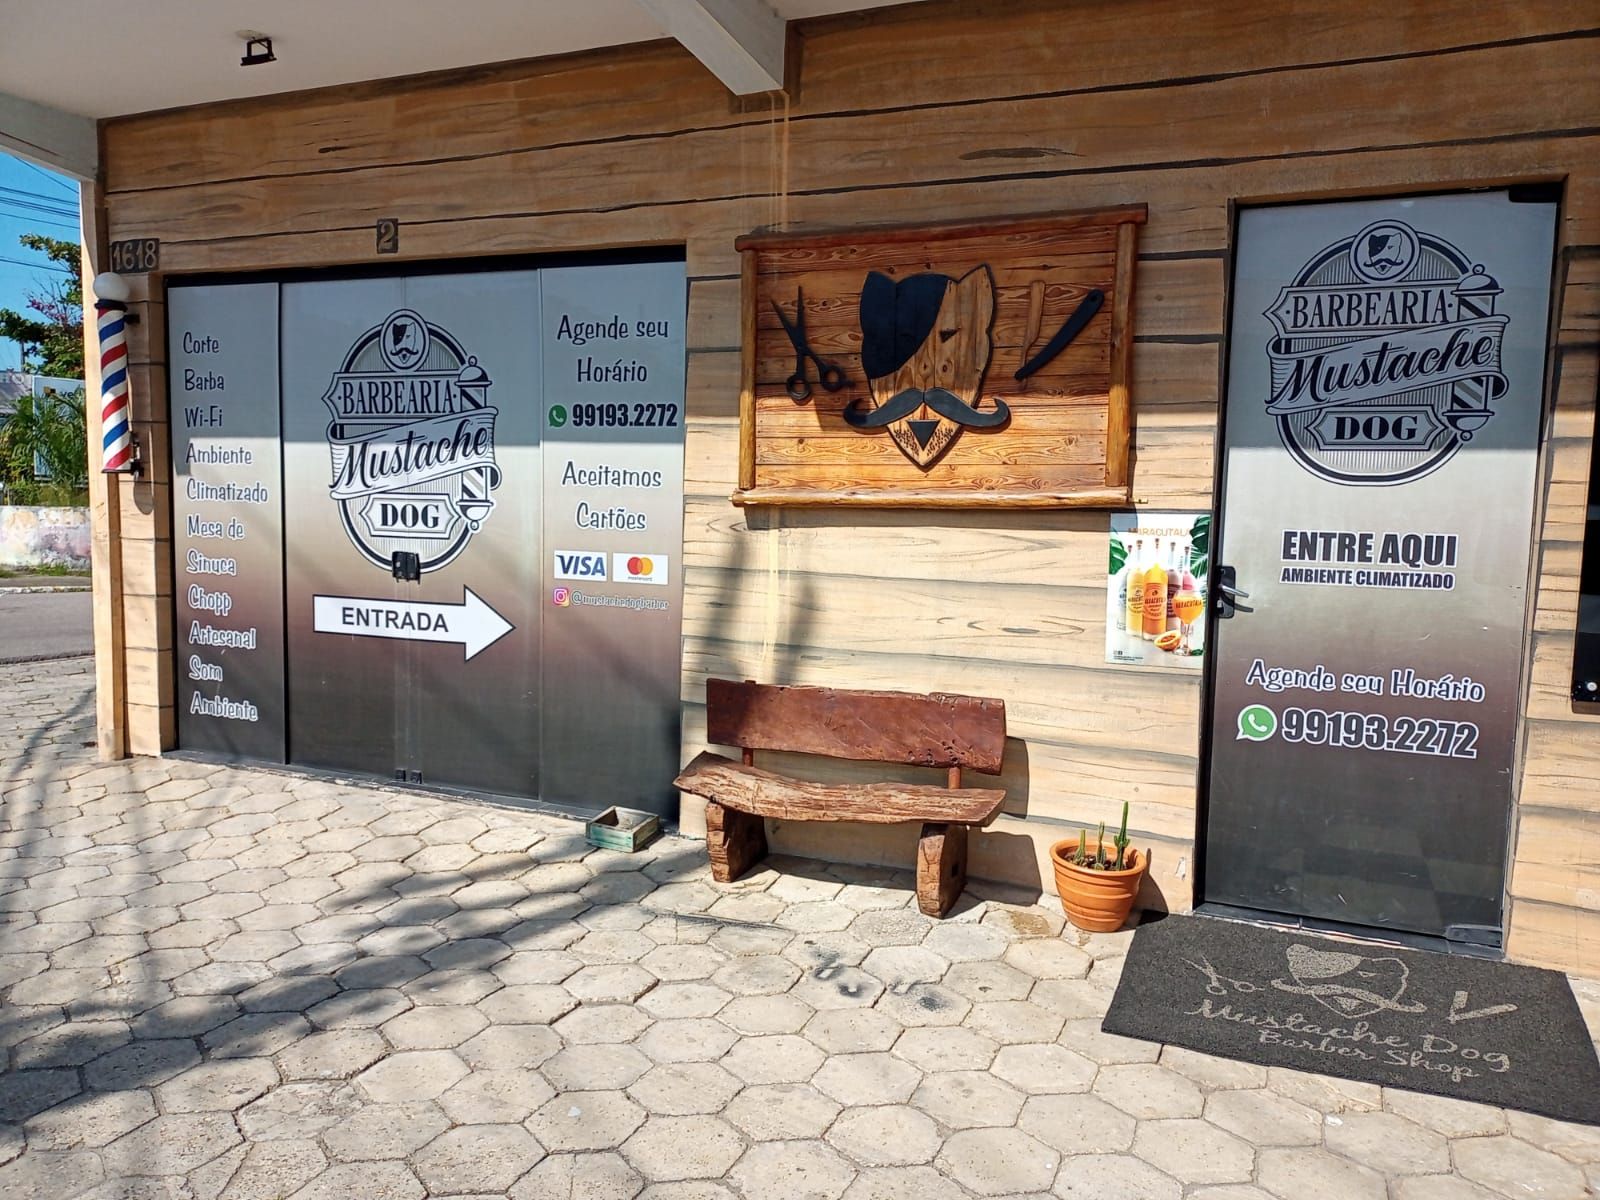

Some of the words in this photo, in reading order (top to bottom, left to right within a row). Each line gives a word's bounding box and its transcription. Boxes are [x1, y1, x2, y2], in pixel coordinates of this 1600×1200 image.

[380, 221, 395, 250] 2
[112, 240, 157, 270] 1618
[1291, 289, 1450, 329] BARBEARIA
[183, 331, 220, 354] Corte
[556, 314, 629, 346] Agende
[636, 321, 669, 338] seu
[184, 368, 225, 391] Barba
[577, 356, 648, 383] Horário
[1264, 327, 1495, 405] Mustache
[342, 379, 456, 415] BARBEARIA
[184, 405, 224, 429] Wi-Fi
[572, 403, 678, 427] 99193.2272
[1334, 415, 1418, 441] DOG
[186, 443, 253, 465] Ambiente
[328, 418, 490, 489] Mustache
[562, 461, 662, 487] Aceitamos
[186, 478, 269, 503] Climatizado
[187, 514, 224, 538] Mesa
[227, 518, 245, 540] de
[380, 502, 441, 529] DOG
[576, 502, 647, 530] Cartões
[186, 548, 237, 576] Sinuca
[1281, 530, 1374, 563] ENTRE
[1379, 533, 1458, 568] AQUI
[555, 555, 606, 577] VISA
[1281, 568, 1353, 585] AMBIENTE
[1355, 570, 1455, 590] CLIMATIZADO
[187, 583, 233, 616] Chopp
[342, 606, 450, 633] ENTRADA
[189, 620, 257, 650] Artesanal
[188, 654, 223, 682] Som
[1246, 658, 1336, 692] Agende
[1343, 672, 1384, 695] seu
[1391, 669, 1486, 702] Horário
[190, 691, 259, 722] Ambiente
[1281, 707, 1479, 759] 99193.2272
[1184, 999, 1410, 1047] Mustache
[1419, 1033, 1511, 1073] Dog
[1258, 1029, 1377, 1061] Barber
[1383, 1049, 1481, 1083] Shop
